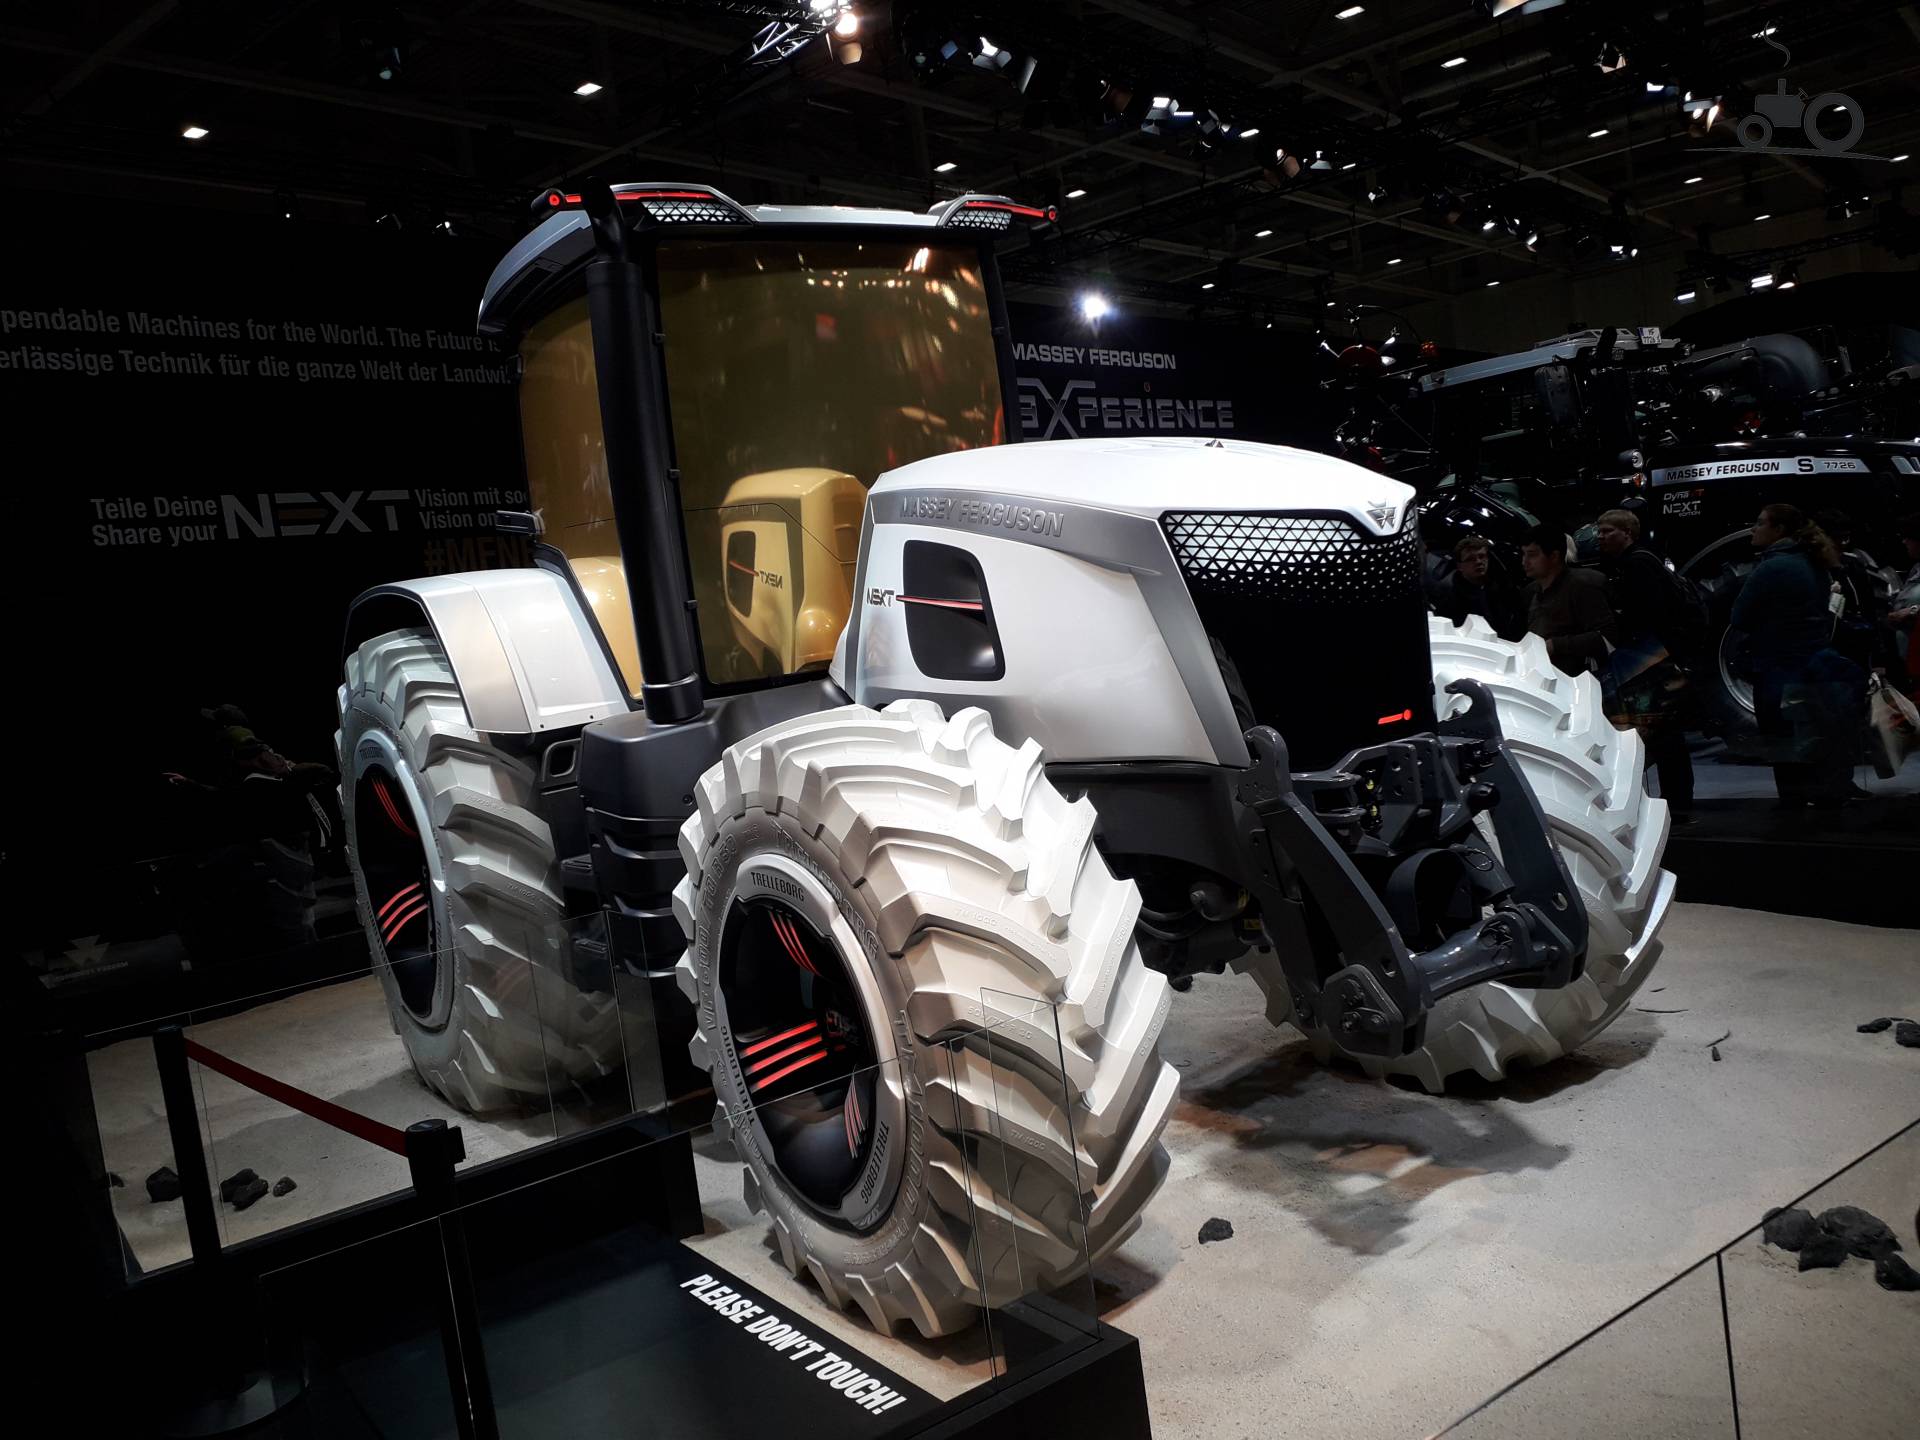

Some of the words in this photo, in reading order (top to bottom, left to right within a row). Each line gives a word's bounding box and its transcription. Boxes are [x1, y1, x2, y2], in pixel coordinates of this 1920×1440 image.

[127, 311, 241, 340] Machines
[247, 318, 277, 341] for
[282, 321, 317, 343] the
[320, 322, 384, 347] World.
[386, 327, 422, 348] The
[425, 329, 484, 352] Future
[118, 349, 214, 375] Technik
[218, 352, 251, 376] für
[257, 355, 290, 377] die
[295, 360, 357, 383] ganze
[359, 360, 404, 381] Welt
[408, 361, 438, 383] der
[443, 362, 512, 384] Landwi
[1012, 343, 1086, 365] MASSEY
[1089, 348, 1177, 370] FERGUSON
[1666, 467, 1712, 481] MASSEY
[1716, 461, 1780, 475] FERGUSON
[1797, 458, 1814, 473] S
[1823, 461, 1856, 470] 7726
[90, 497, 148, 521] Teile
[153, 496, 218, 518] Deine
[414, 488, 469, 507] Vision
[473, 486, 502, 506] mit
[1663, 500, 1702, 514] NEXT
[220, 489, 411, 540] NEXT
[418, 510, 473, 530] Vision
[902, 496, 955, 519] MASSEY
[959, 500, 1066, 538] FERGUSON
[91, 523, 163, 547] Share
[168, 523, 219, 548] your
[866, 588, 895, 607] NEXT
[751, 871, 805, 902] TRELLEBORG
[863, 1120, 890, 1205] TRELLEBORG
[680, 1273, 765, 1325] PLEASE
[744, 1315, 825, 1361] DON'T
[805, 1352, 908, 1415] TOUCH!
